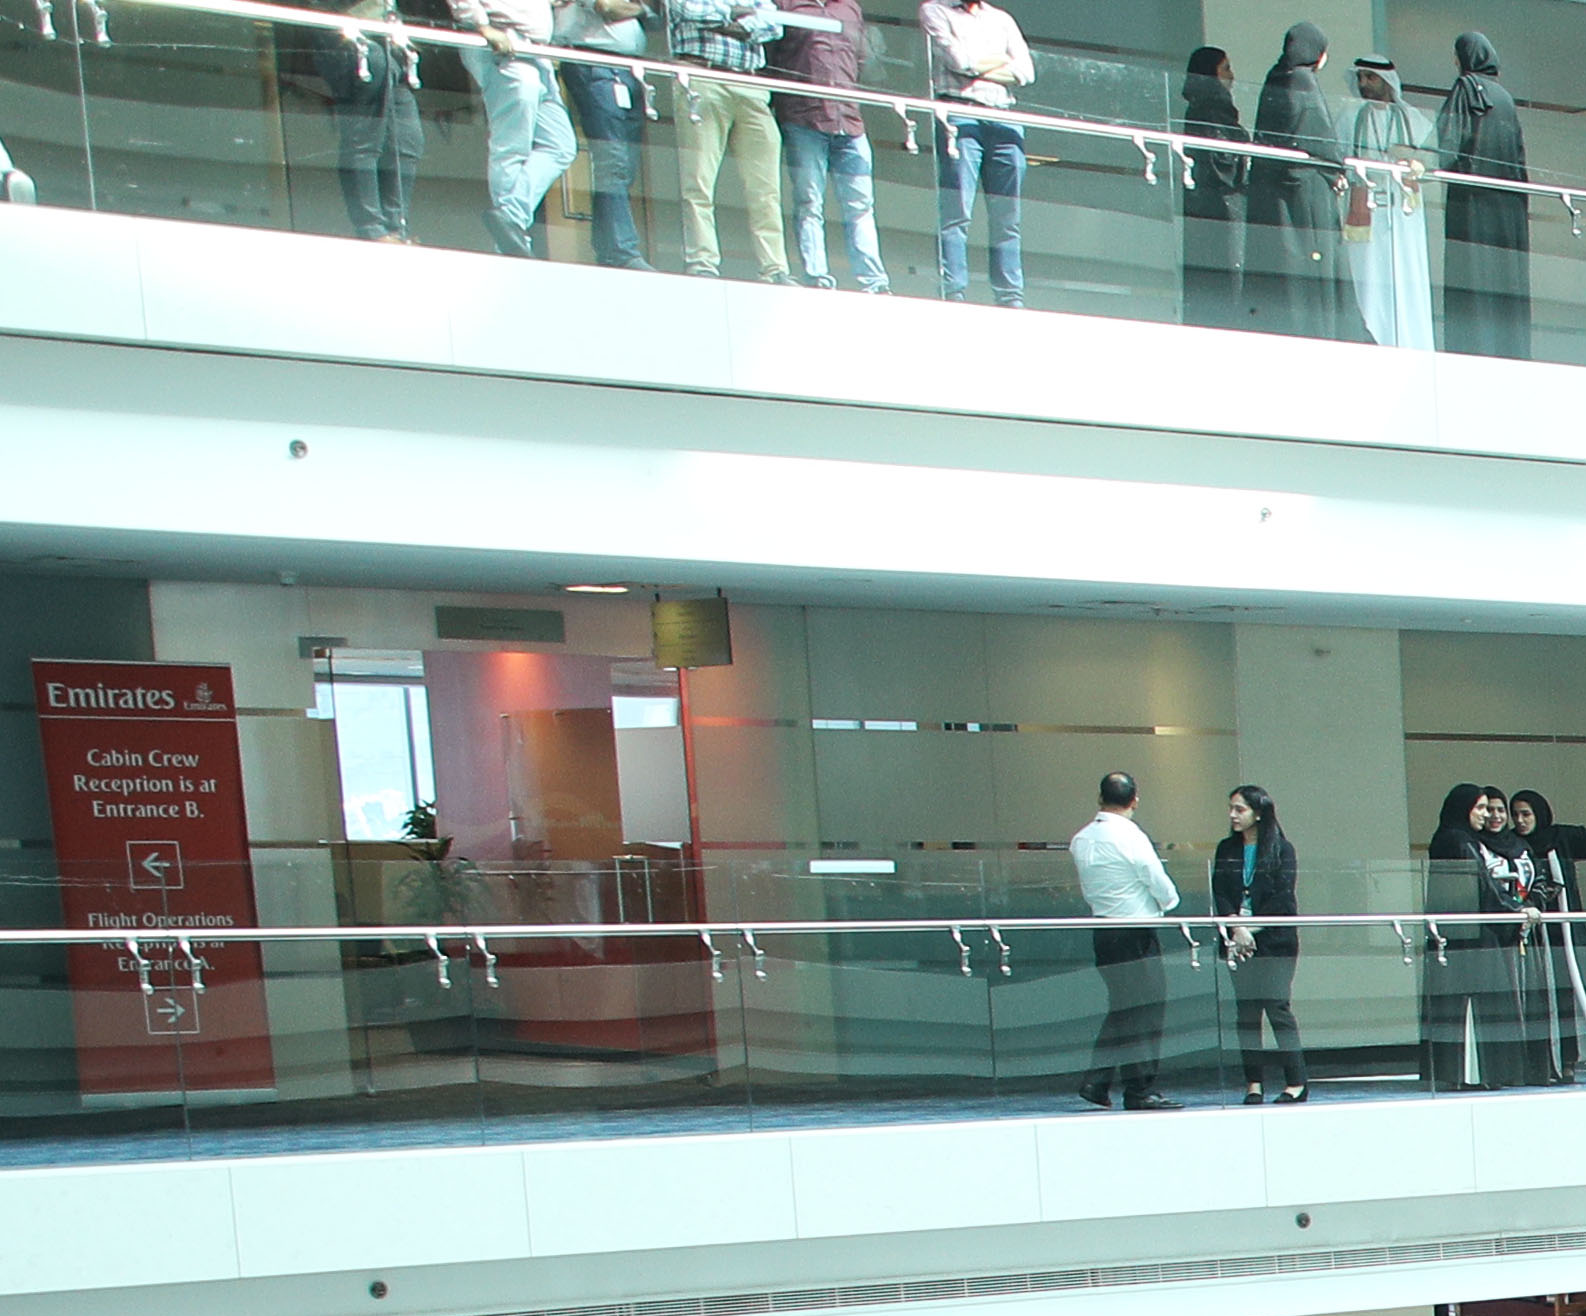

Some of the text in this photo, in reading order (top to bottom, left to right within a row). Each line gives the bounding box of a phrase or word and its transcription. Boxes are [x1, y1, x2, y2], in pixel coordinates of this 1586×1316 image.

[46, 682, 176, 710] Emirates
[86, 749, 200, 768] Cabin Crew
[73, 774, 217, 797] Reception is at
[92, 800, 205, 818] Entrance B.
[88, 912, 234, 929] Flight Operations
